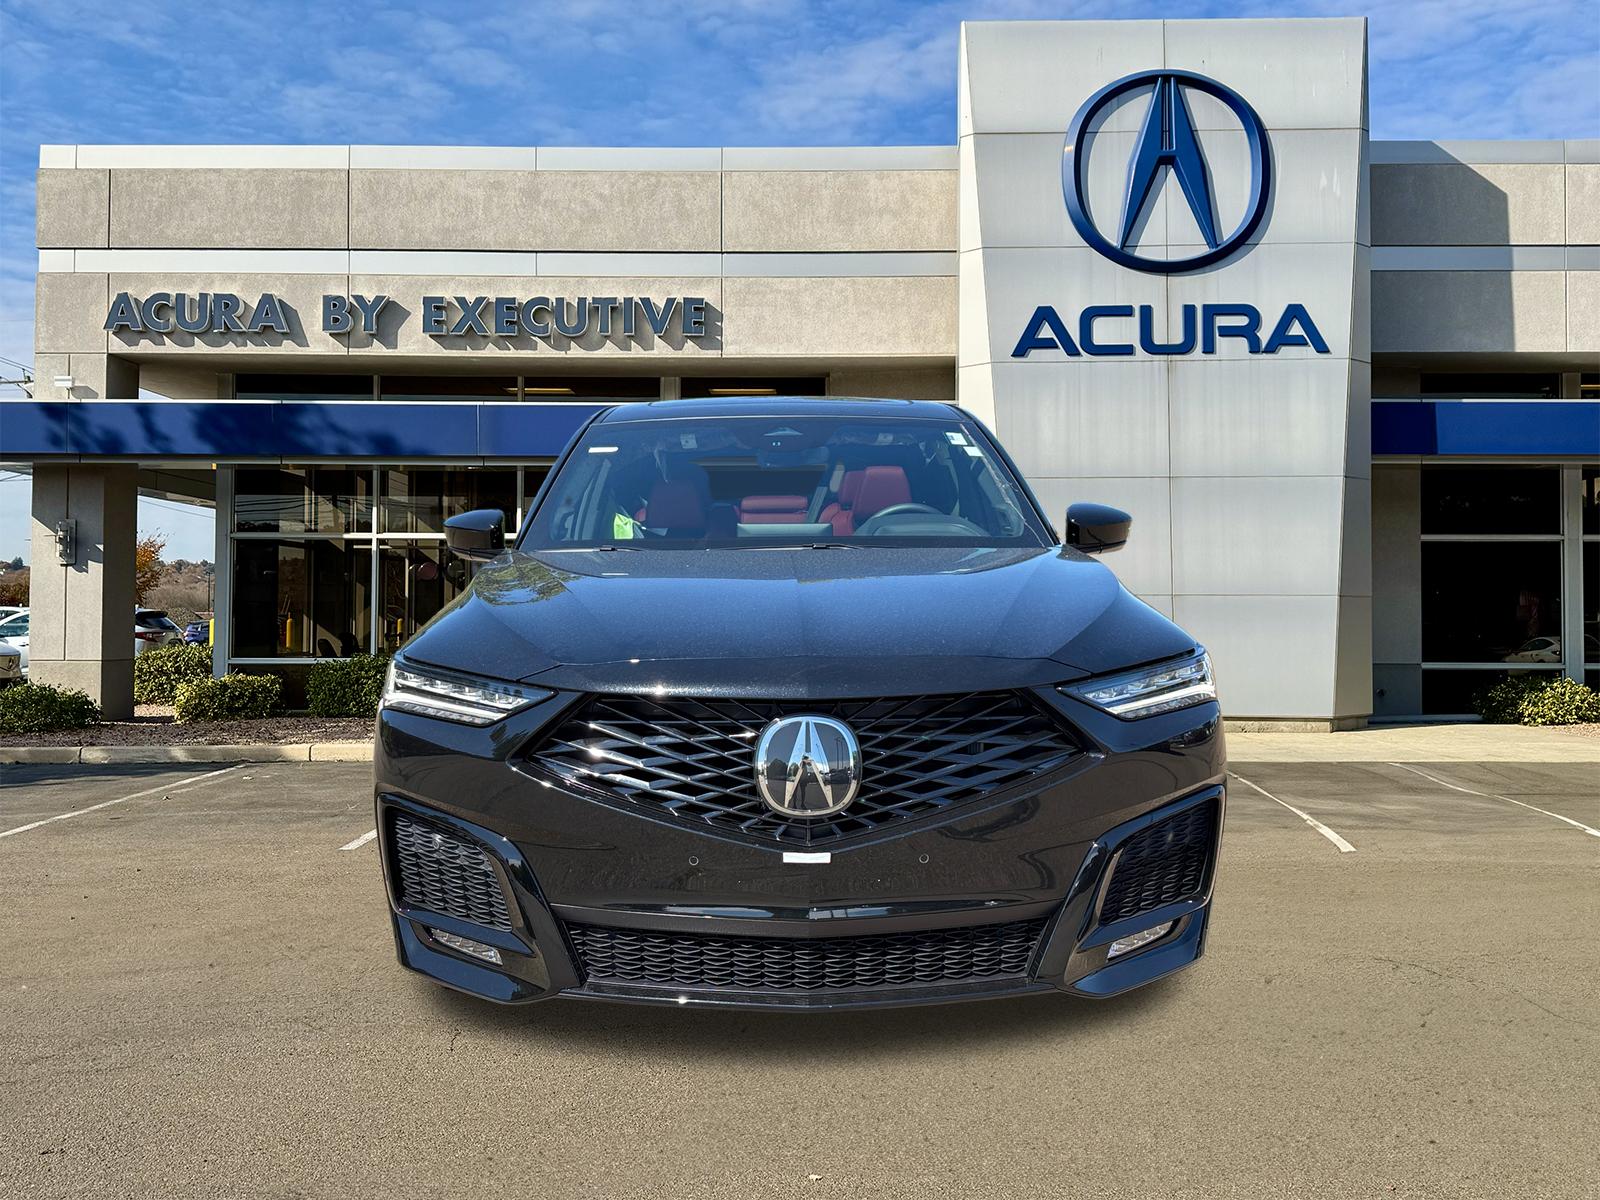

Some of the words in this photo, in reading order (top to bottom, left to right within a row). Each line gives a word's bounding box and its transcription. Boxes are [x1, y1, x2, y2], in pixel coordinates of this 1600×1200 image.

[104, 292, 291, 334] ACURA
[322, 294, 389, 334] BY
[422, 296, 707, 336] EXECUTIVE
[1011, 303, 1332, 357] ACURA
